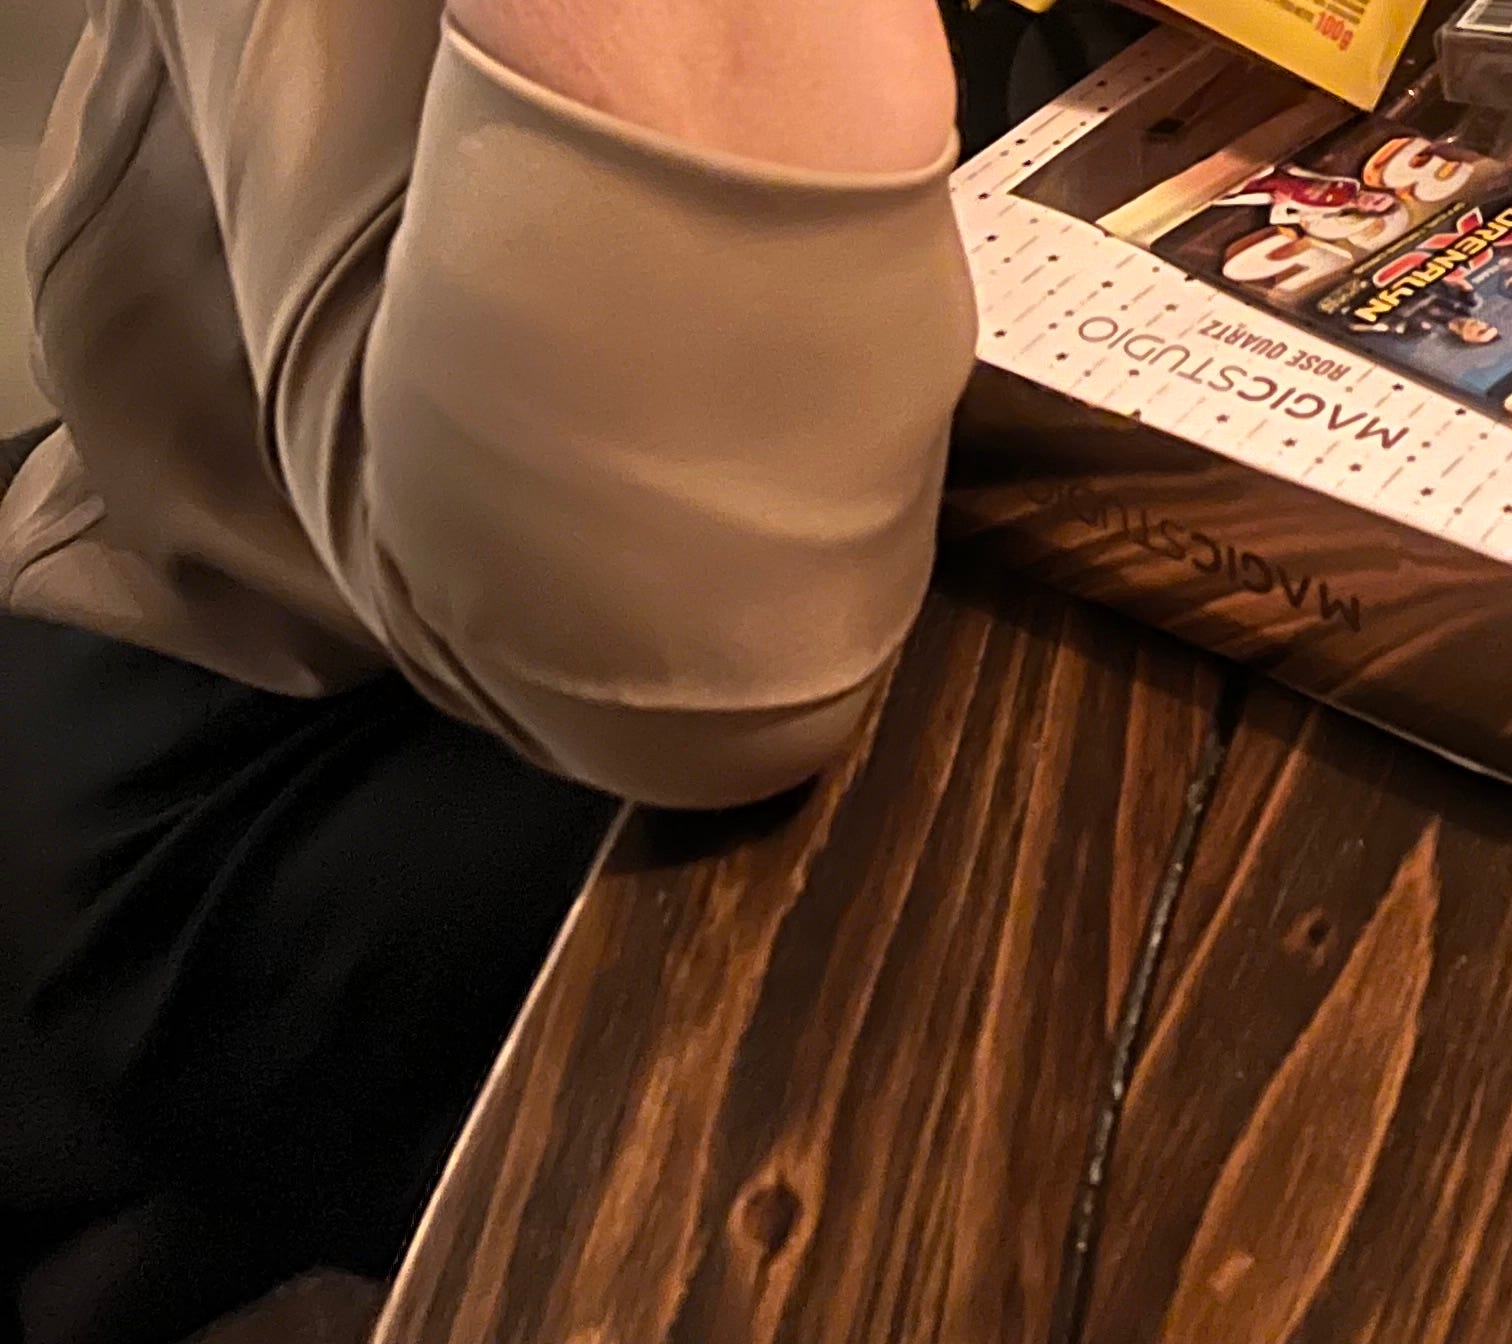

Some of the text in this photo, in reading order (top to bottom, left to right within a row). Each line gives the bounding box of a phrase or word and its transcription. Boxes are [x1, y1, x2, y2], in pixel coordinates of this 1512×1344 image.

[1077, 315, 1410, 451] MAGICSTUDIO
[1198, 319, 1352, 383] ROSE QUARTZ
